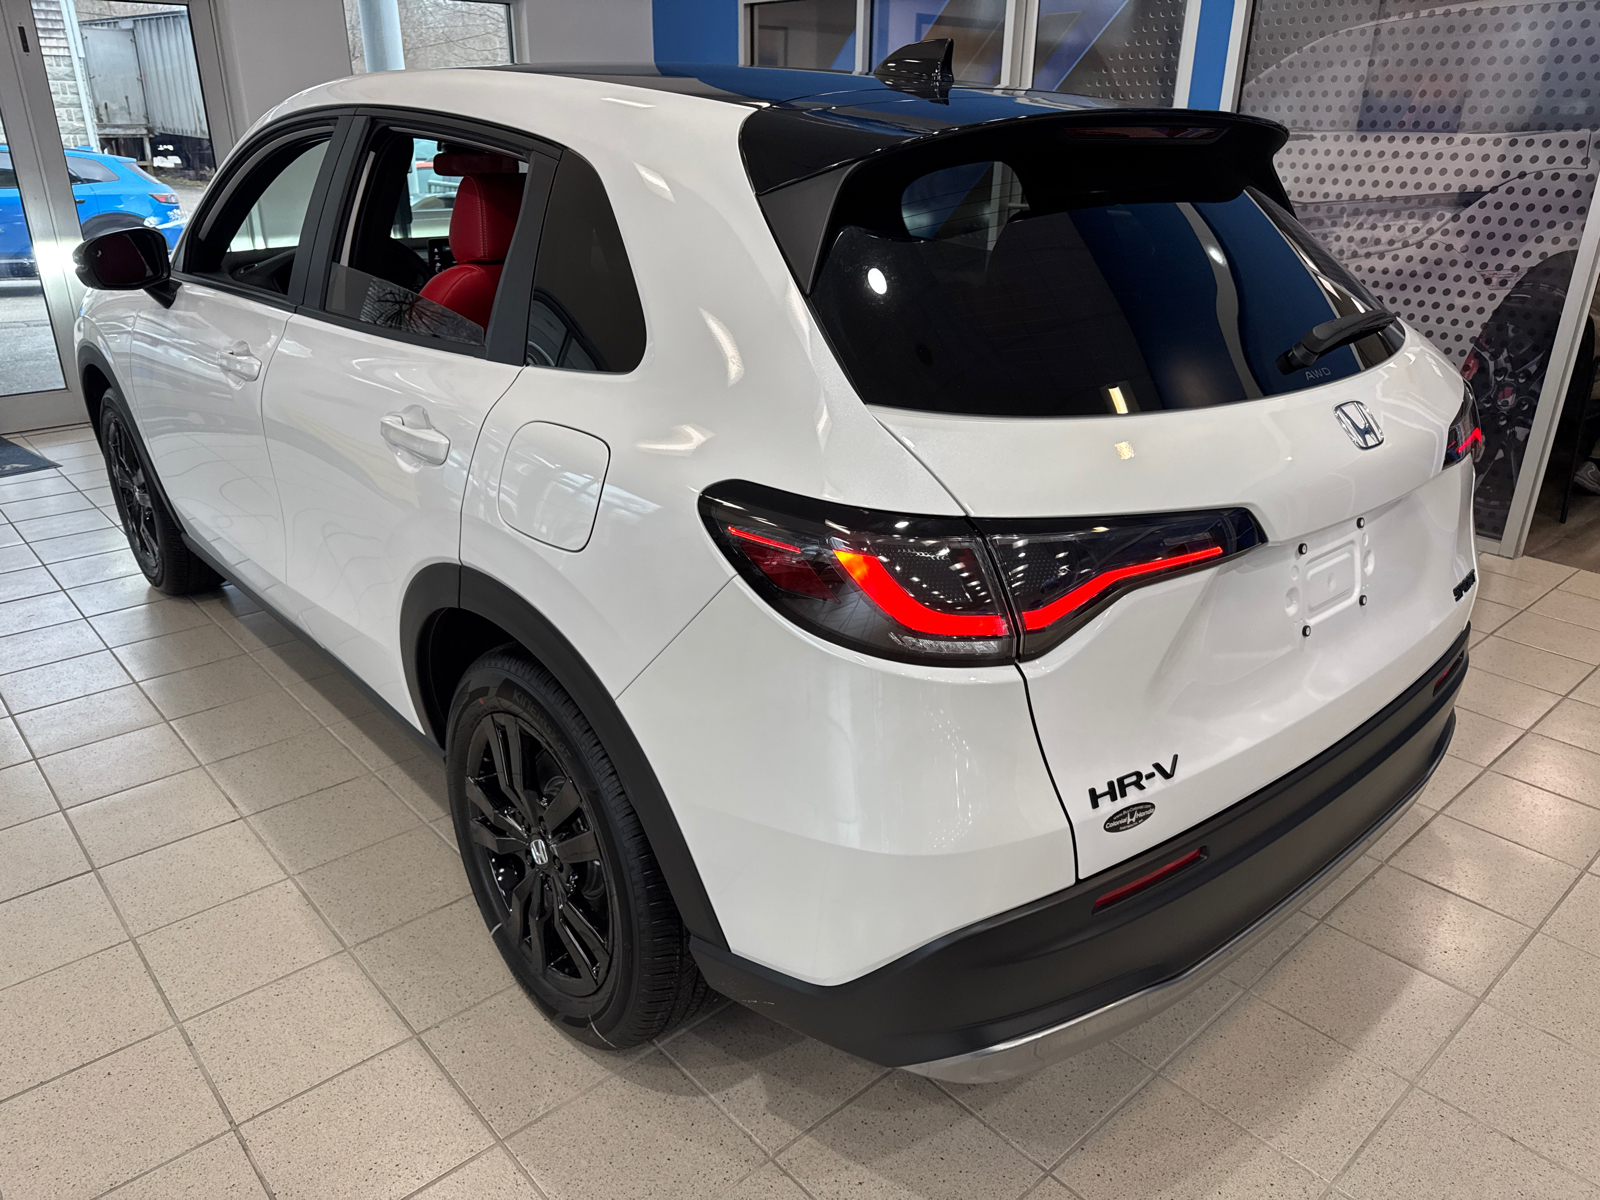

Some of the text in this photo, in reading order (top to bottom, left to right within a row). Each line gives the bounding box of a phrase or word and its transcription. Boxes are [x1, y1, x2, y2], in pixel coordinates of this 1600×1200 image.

[1305, 367, 1331, 380] AWD
[1088, 753, 1178, 810] HR-V
[1105, 817, 1128, 829] Colonial
[1136, 808, 1155, 818] Honda
